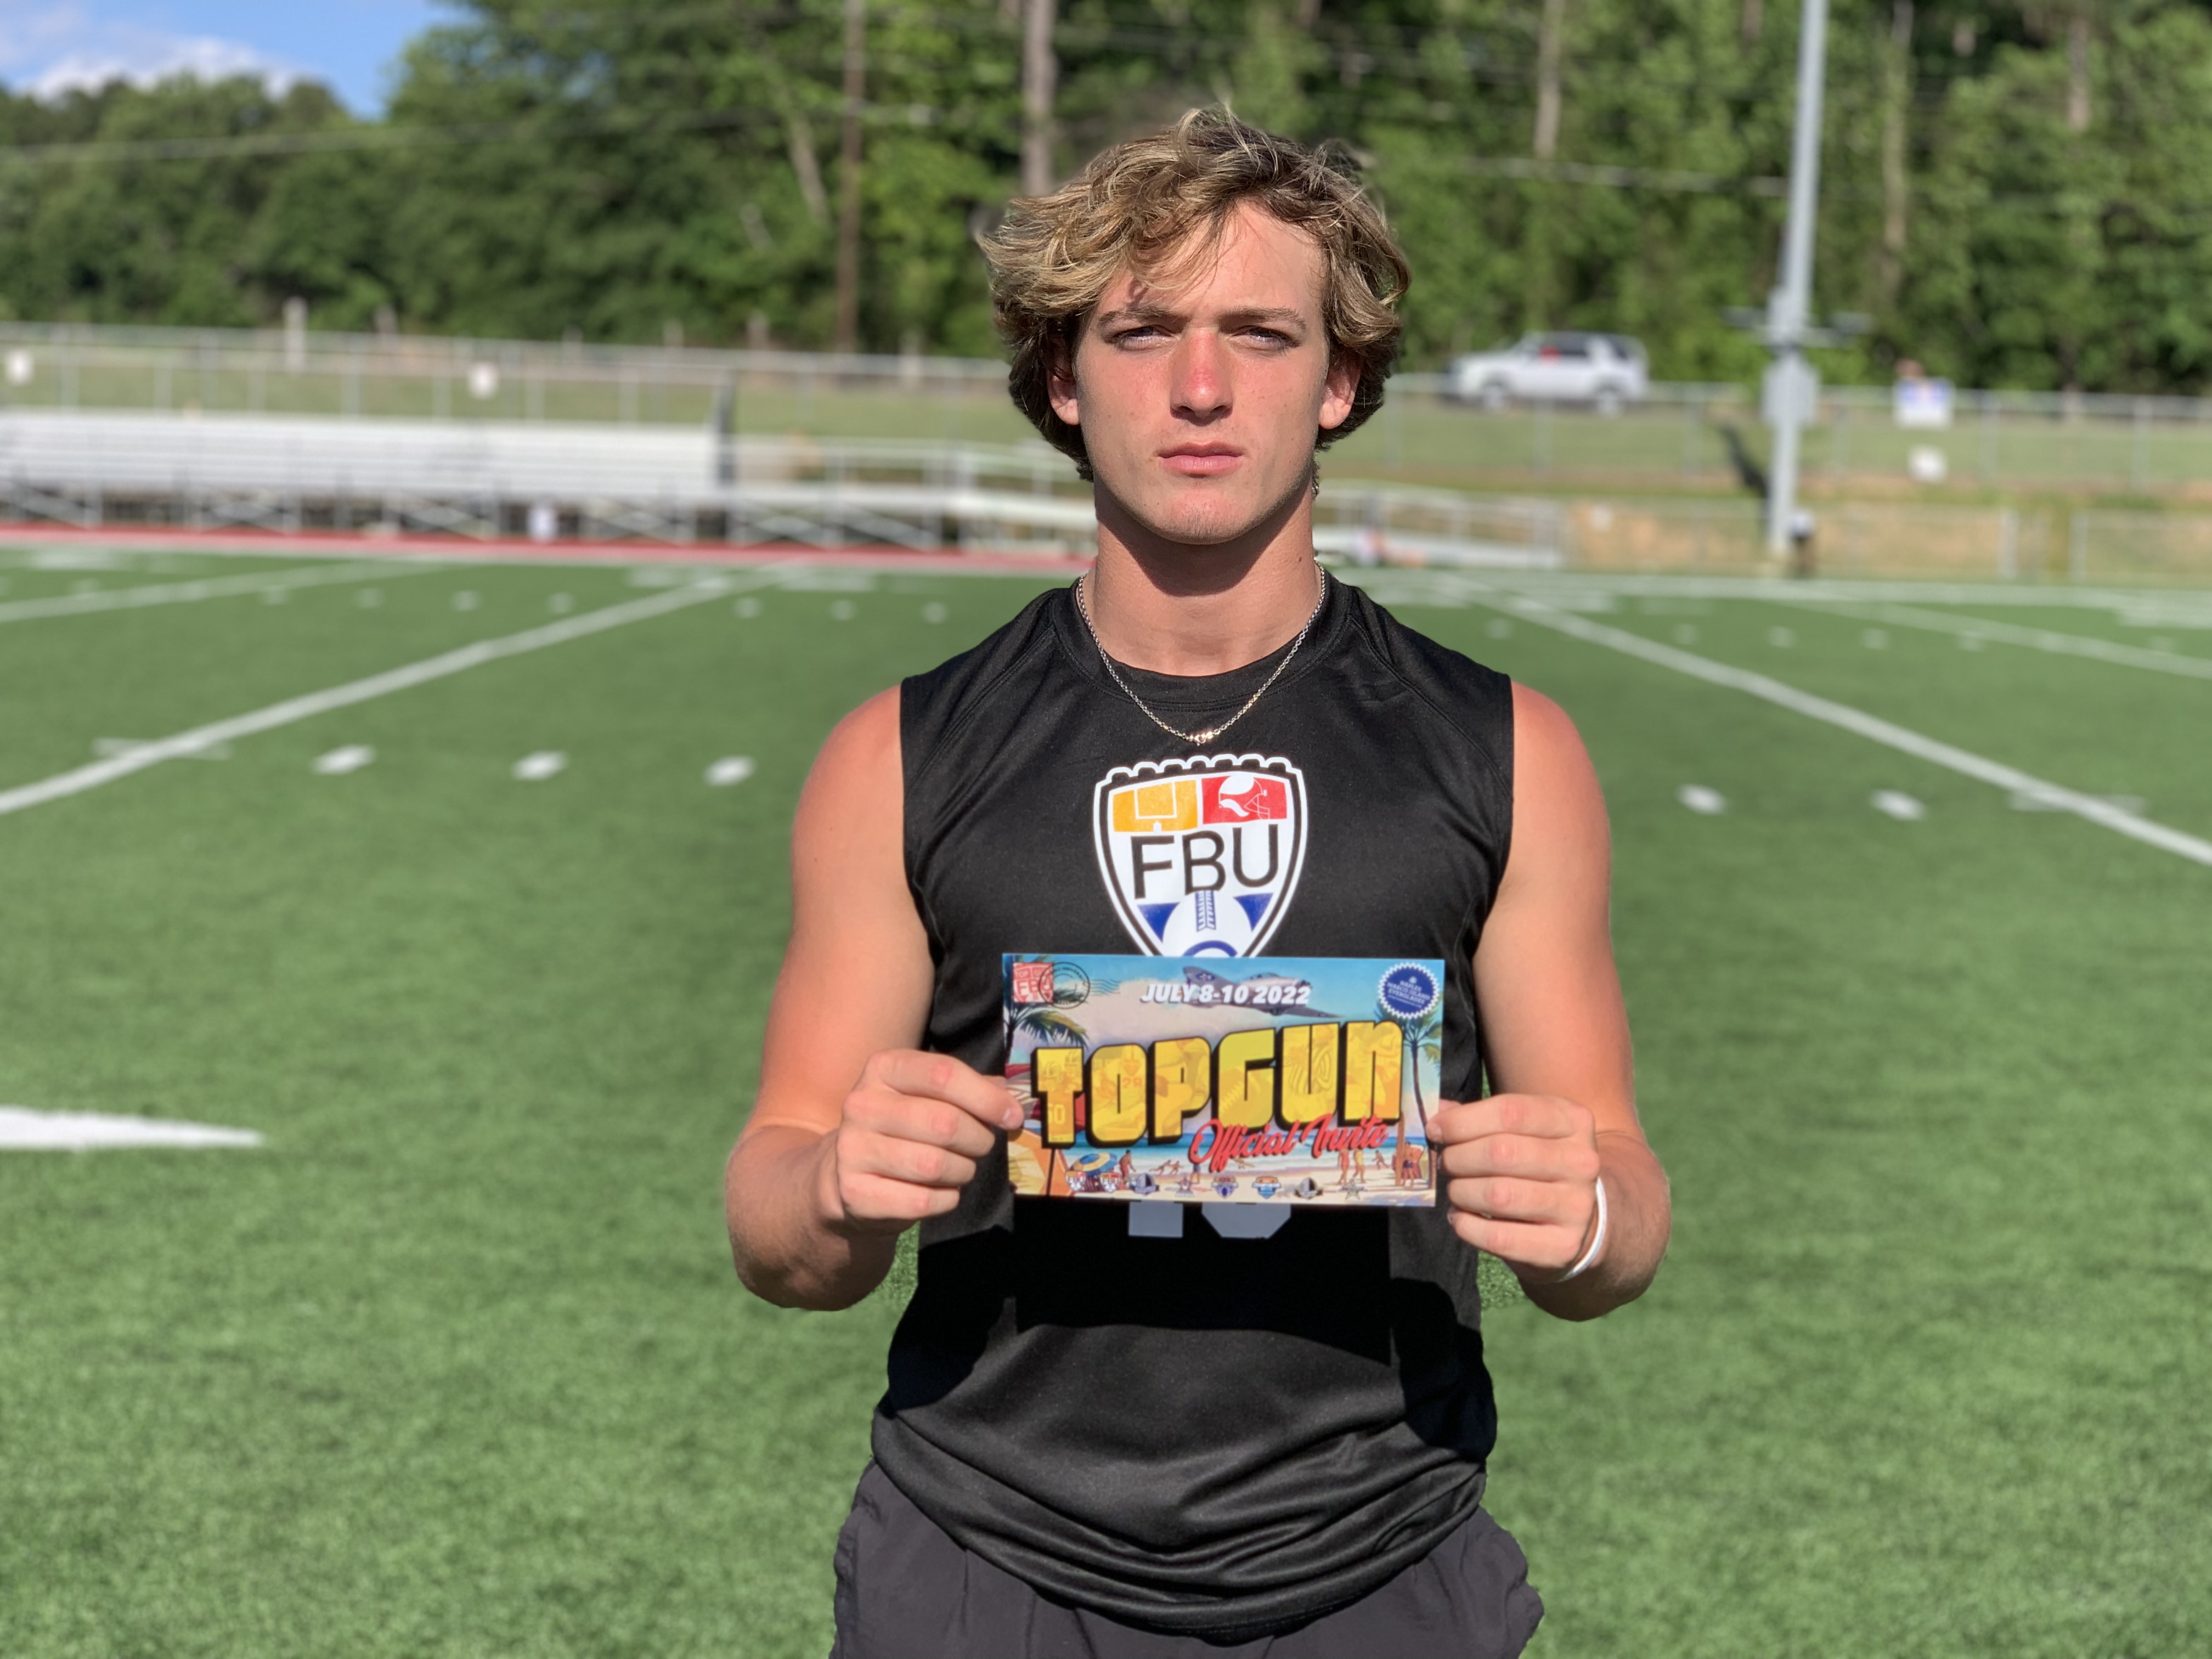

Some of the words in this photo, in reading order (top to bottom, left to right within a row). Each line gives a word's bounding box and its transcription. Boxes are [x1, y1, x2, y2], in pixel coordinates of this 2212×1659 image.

[1131, 824, 1278, 900] FBU
[1015, 970, 1028, 978] TOP
[1141, 984, 1195, 1003] JULY
[1198, 985, 1249, 1003] 8-10
[1252, 985, 1311, 1004] 2022
[1387, 982, 1409, 993] MARCO
[1409, 989, 1430, 1000] ISLAND
[1400, 980, 1422, 992] NAPLES
[1388, 988, 1425, 1005] EVERGLADES
[1031, 1020, 1403, 1149] TOPGUN
[1188, 1119, 1300, 1172] Official
[1298, 1113, 1389, 1158] Invite
